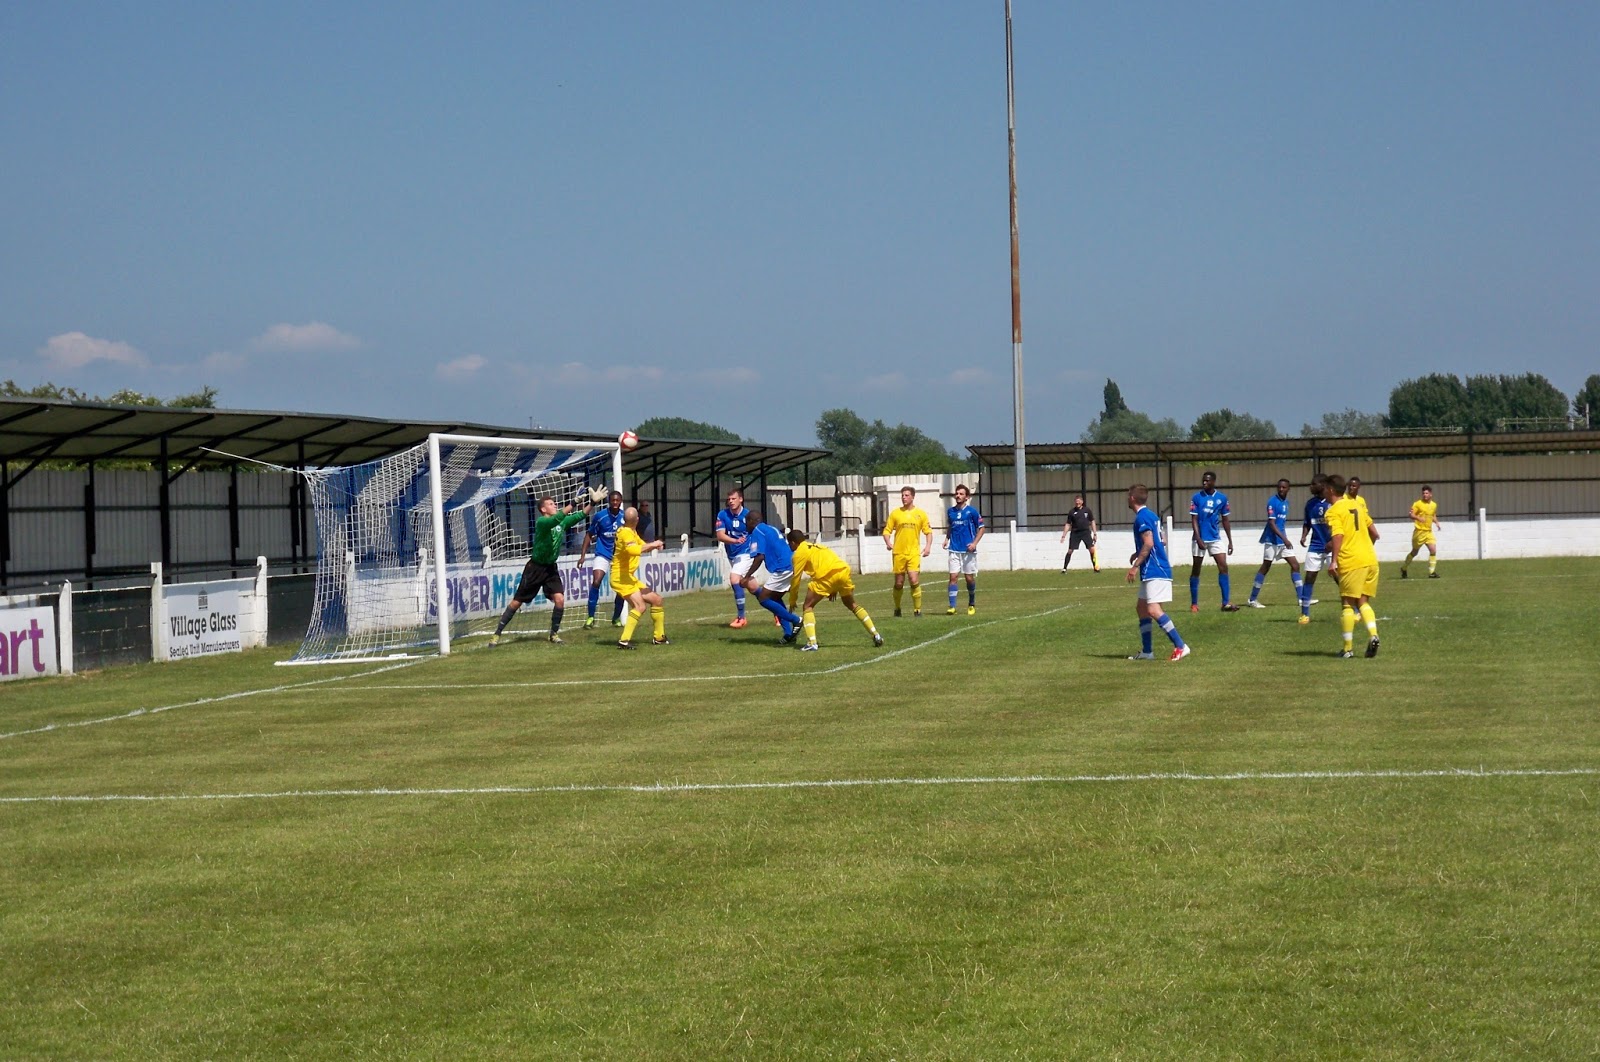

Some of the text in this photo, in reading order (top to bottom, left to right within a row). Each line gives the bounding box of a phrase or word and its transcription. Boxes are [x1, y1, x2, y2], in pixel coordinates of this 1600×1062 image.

[1318, 506, 1324, 516] 3
[1349, 508, 1360, 531] 7
[645, 561, 686, 592] SPICER
[170, 612, 237, 641] Village Glass
[169, 645, 189, 658] Sealed
